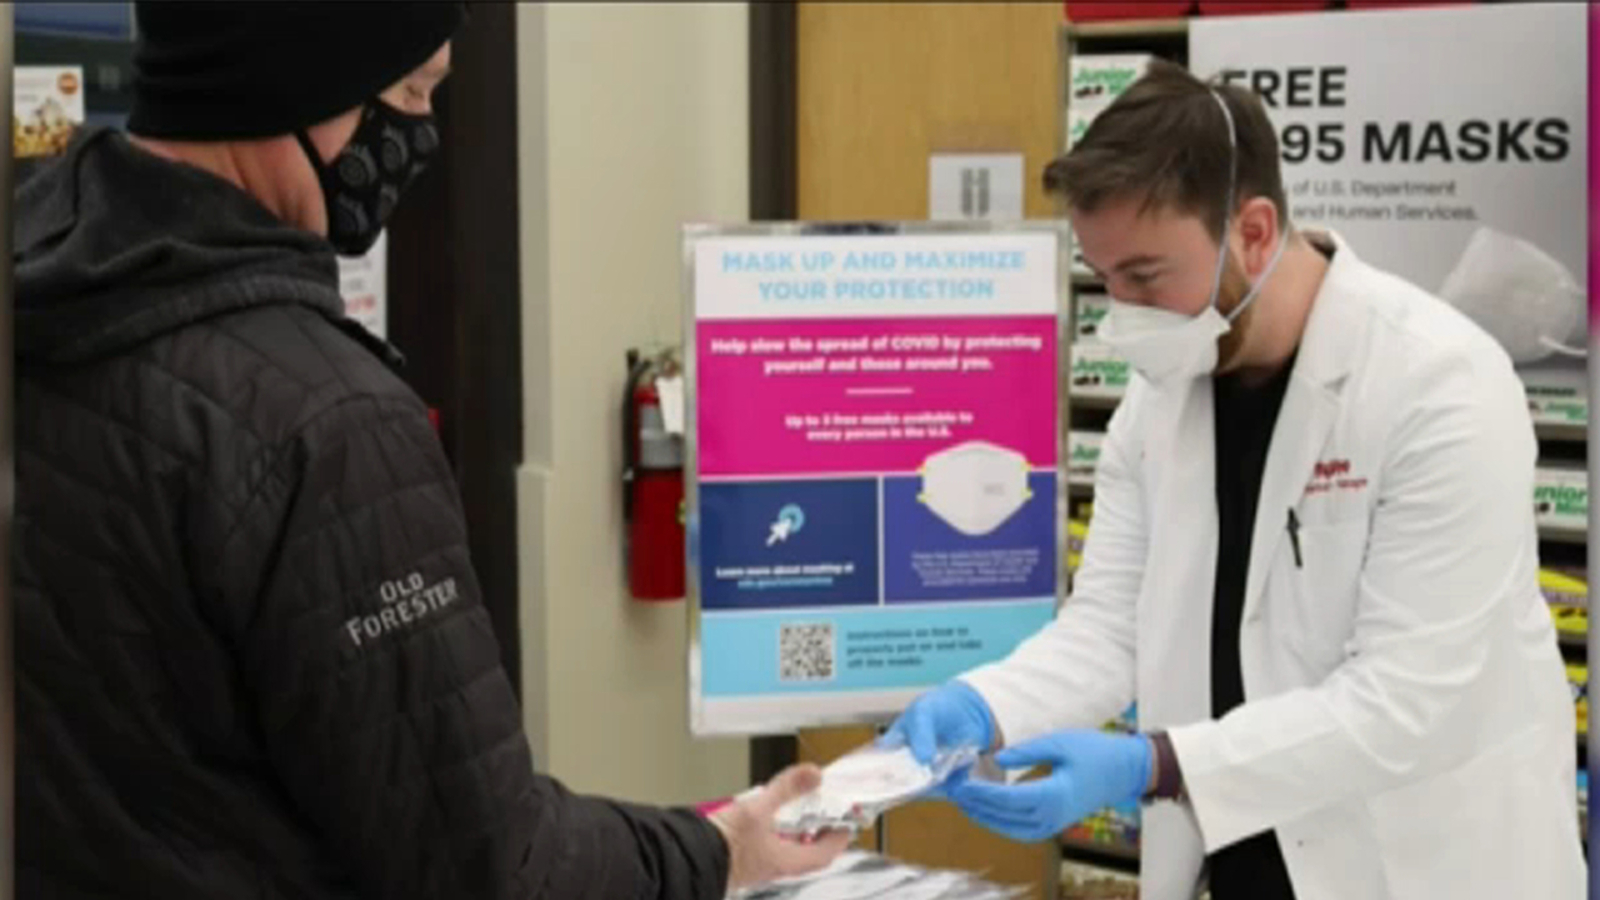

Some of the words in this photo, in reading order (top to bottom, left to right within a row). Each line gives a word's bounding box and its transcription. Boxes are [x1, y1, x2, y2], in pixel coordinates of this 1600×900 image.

[1362, 118, 1571, 163] MASKS
[1293, 180, 1309, 195] of
[1314, 181, 1345, 195] U.S.
[1351, 179, 1456, 198] Department
[1293, 205, 1324, 219] and
[1329, 204, 1391, 219] Human
[1396, 203, 1479, 219] Services.
[721, 250, 795, 273] MASK
[801, 250, 835, 272] UP
[842, 250, 897, 271] AND
[905, 249, 1025, 270] MAXIMIZE
[758, 280, 827, 301] YOUR
[836, 278, 994, 300] PROTECTION
[711, 337, 747, 355] Help
[751, 337, 785, 352] slow
[789, 336, 813, 352] the
[817, 336, 868, 355] spread
[872, 335, 889, 351] of
[891, 335, 940, 351] COVID
[943, 335, 961, 353] by
[965, 333, 1042, 352] protecting
[763, 356, 825, 376] yourself
[828, 356, 857, 373] and
[860, 356, 901, 372] those
[905, 355, 958, 371] around
[962, 357, 993, 373] you.
[785, 415, 803, 431] Up
[805, 415, 820, 428] to
[959, 411, 973, 425] to
[904, 426, 925, 439] the
[1533, 484, 1587, 504] unior
[380, 572, 424, 603] OLD
[345, 577, 459, 647] FORESTER
